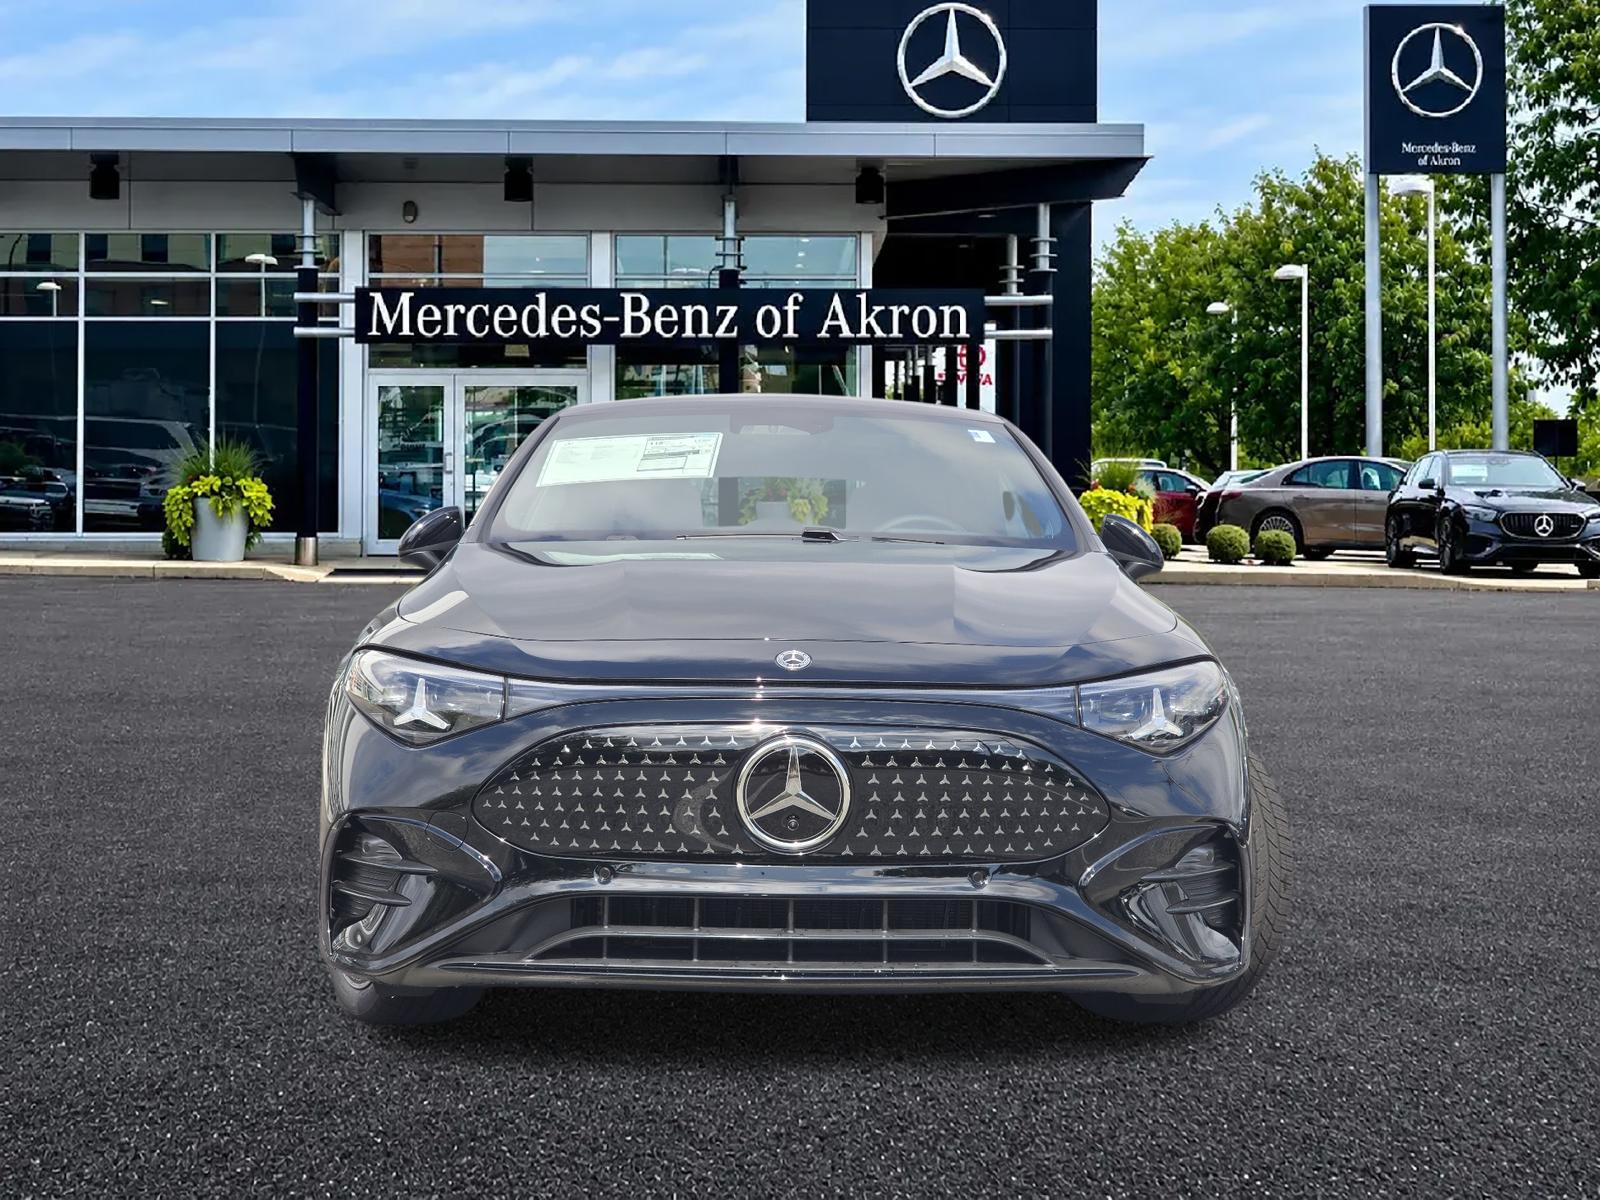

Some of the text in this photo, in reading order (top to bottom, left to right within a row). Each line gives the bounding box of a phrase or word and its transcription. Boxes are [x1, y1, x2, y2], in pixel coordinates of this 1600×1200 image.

[1401, 141, 1477, 154] Mercedes-Benz
[1417, 154, 1461, 166] of Akron
[367, 291, 971, 339] Mercedes-Benz of Akron
